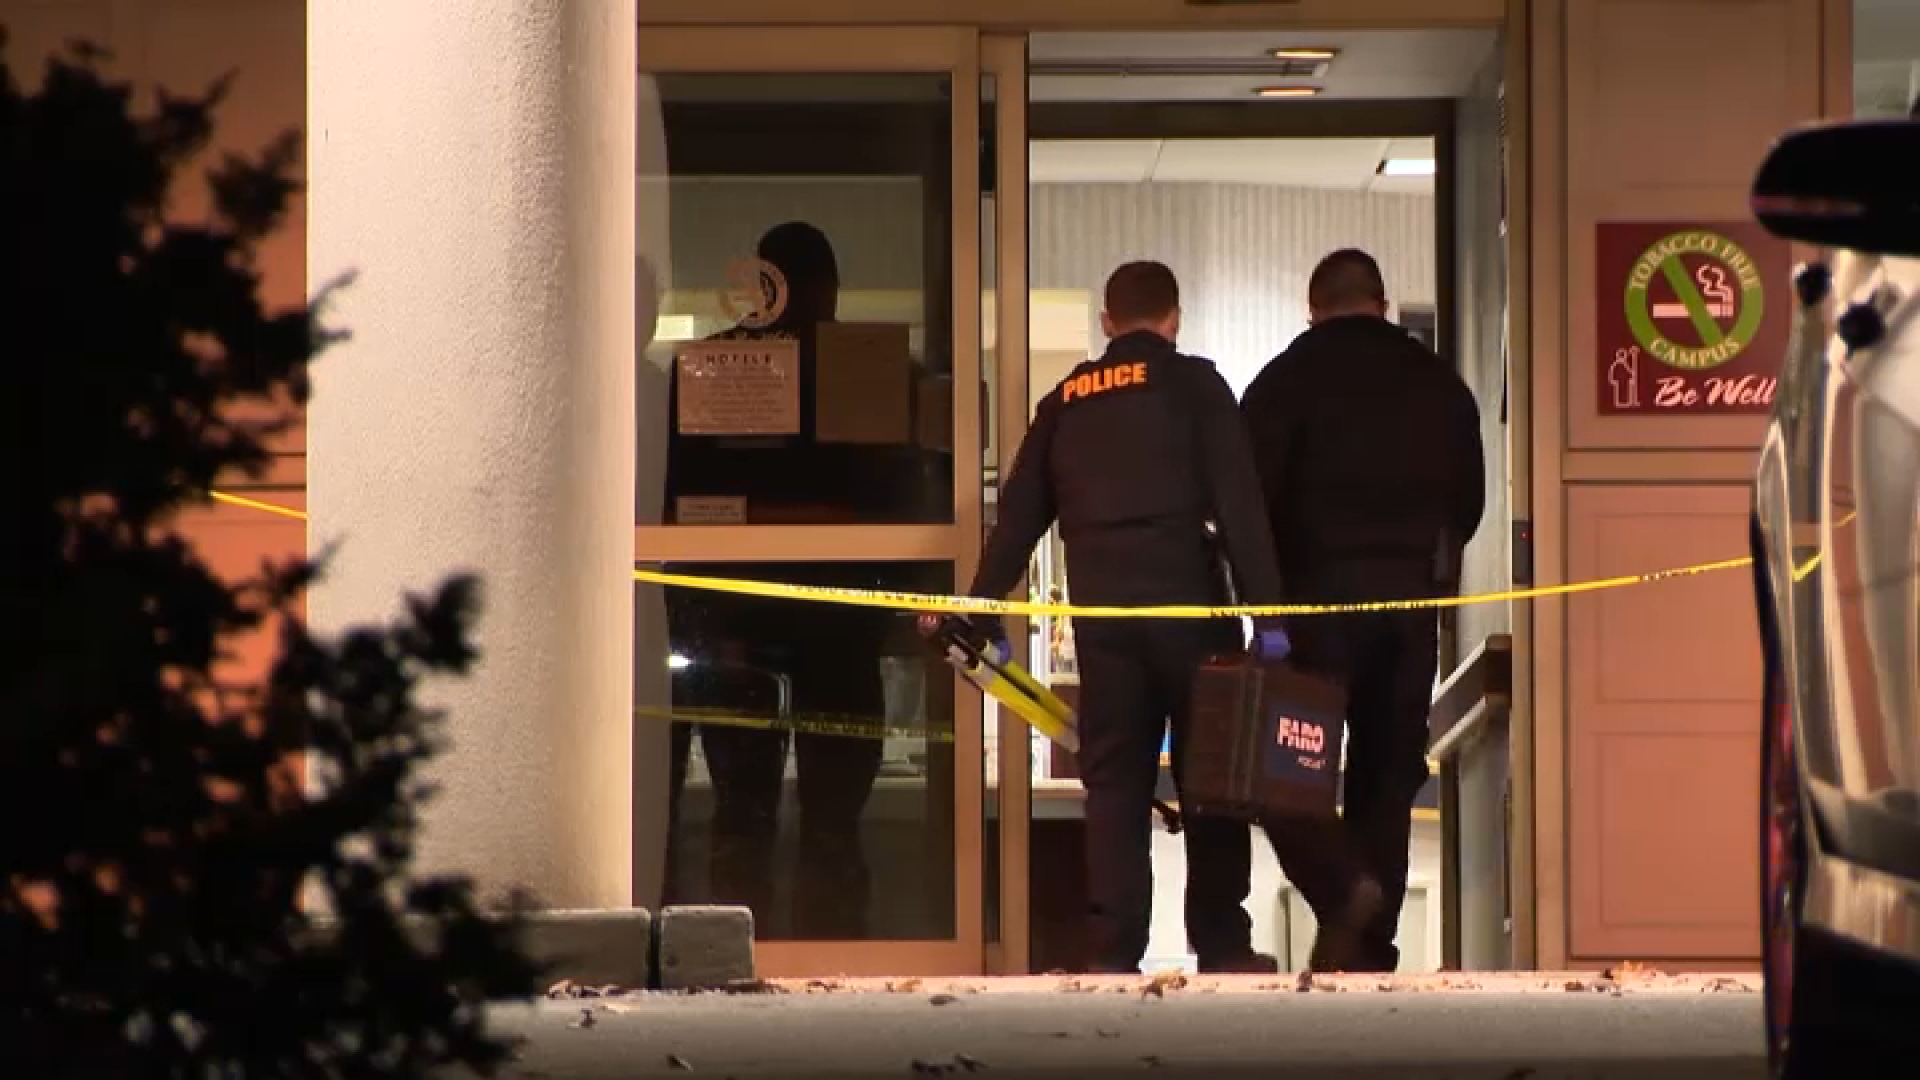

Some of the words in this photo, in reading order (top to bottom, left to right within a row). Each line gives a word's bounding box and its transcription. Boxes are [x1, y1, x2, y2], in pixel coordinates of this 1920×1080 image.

[1630, 234, 1718, 289] TOBACCO
[1720, 244, 1760, 289] FREE
[1651, 337, 1741, 367] CAMPUS
[1063, 362, 1147, 403] POLICE
[1654, 376, 1699, 406] Be
[1704, 374, 1776, 406] Well
[1277, 716, 1324, 753] FARO
